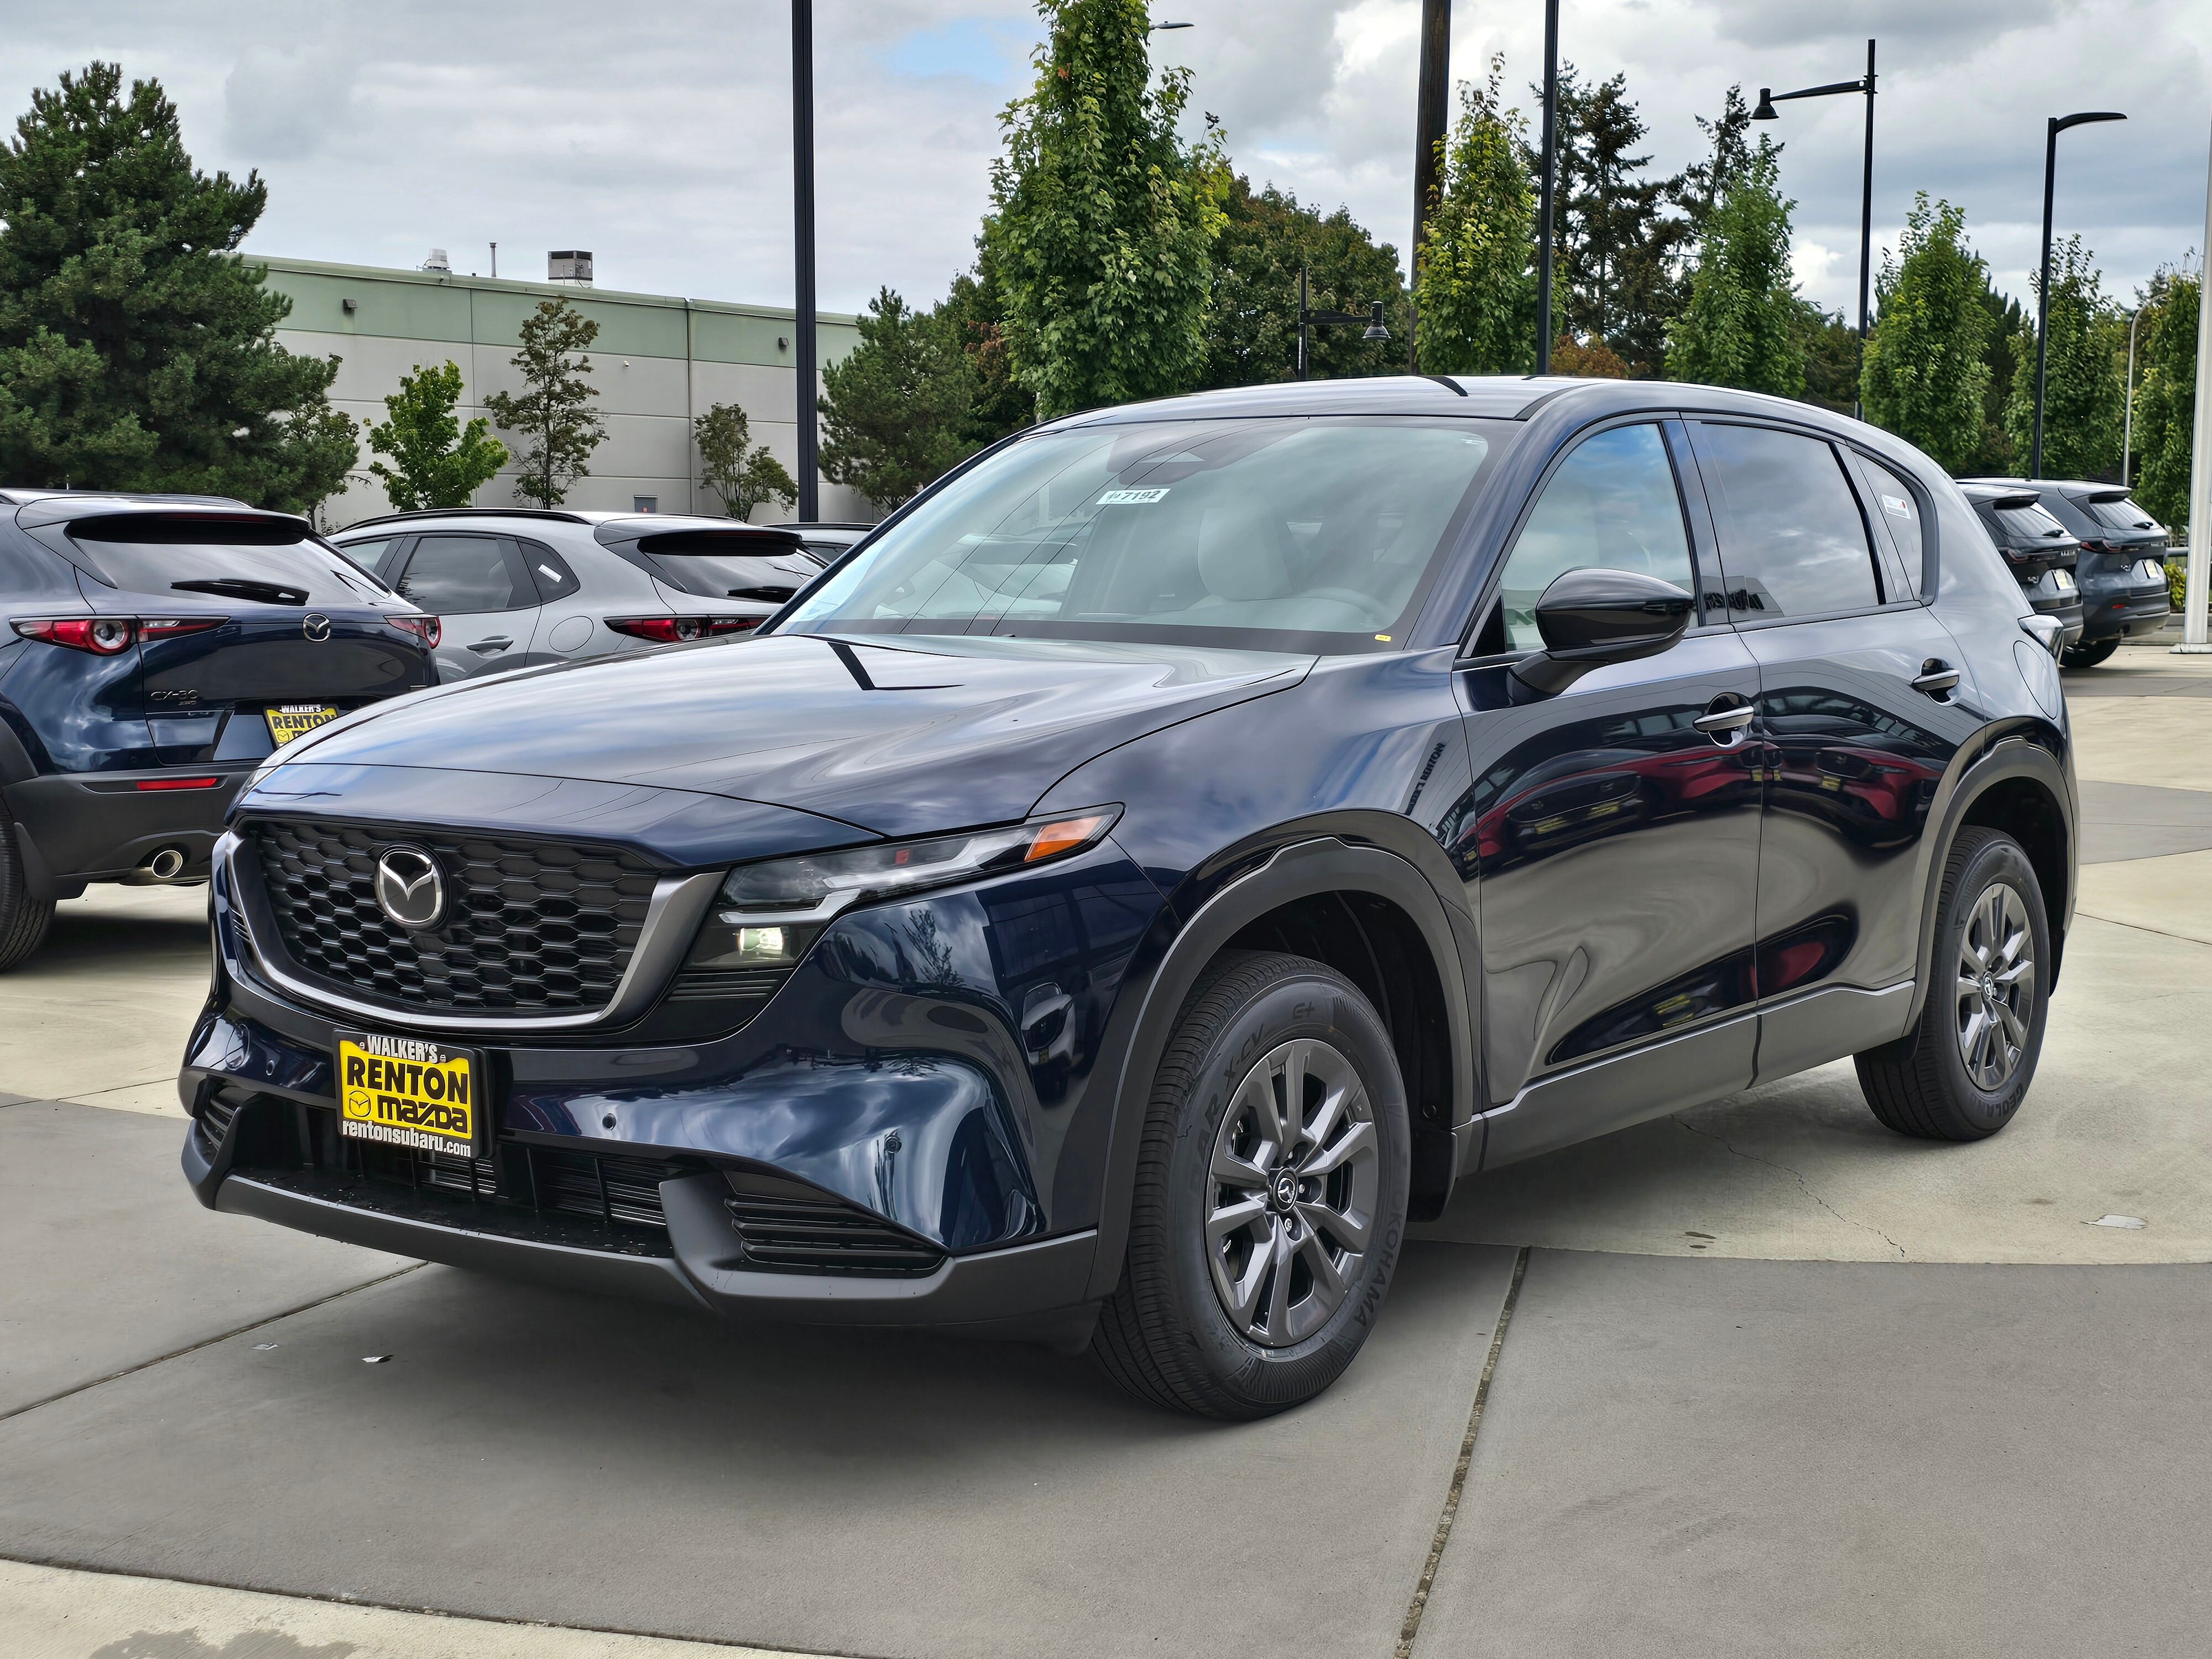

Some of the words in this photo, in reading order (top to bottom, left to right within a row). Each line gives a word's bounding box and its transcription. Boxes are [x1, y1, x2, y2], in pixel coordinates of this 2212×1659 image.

[151, 689, 199, 701] CX-30
[367, 1035, 439, 1064] WALKER'S
[347, 1055, 468, 1105] RENTON
[342, 1119, 471, 1157] rentonsubaru.com
[1353, 1187, 1403, 1327] OKOHAMA
